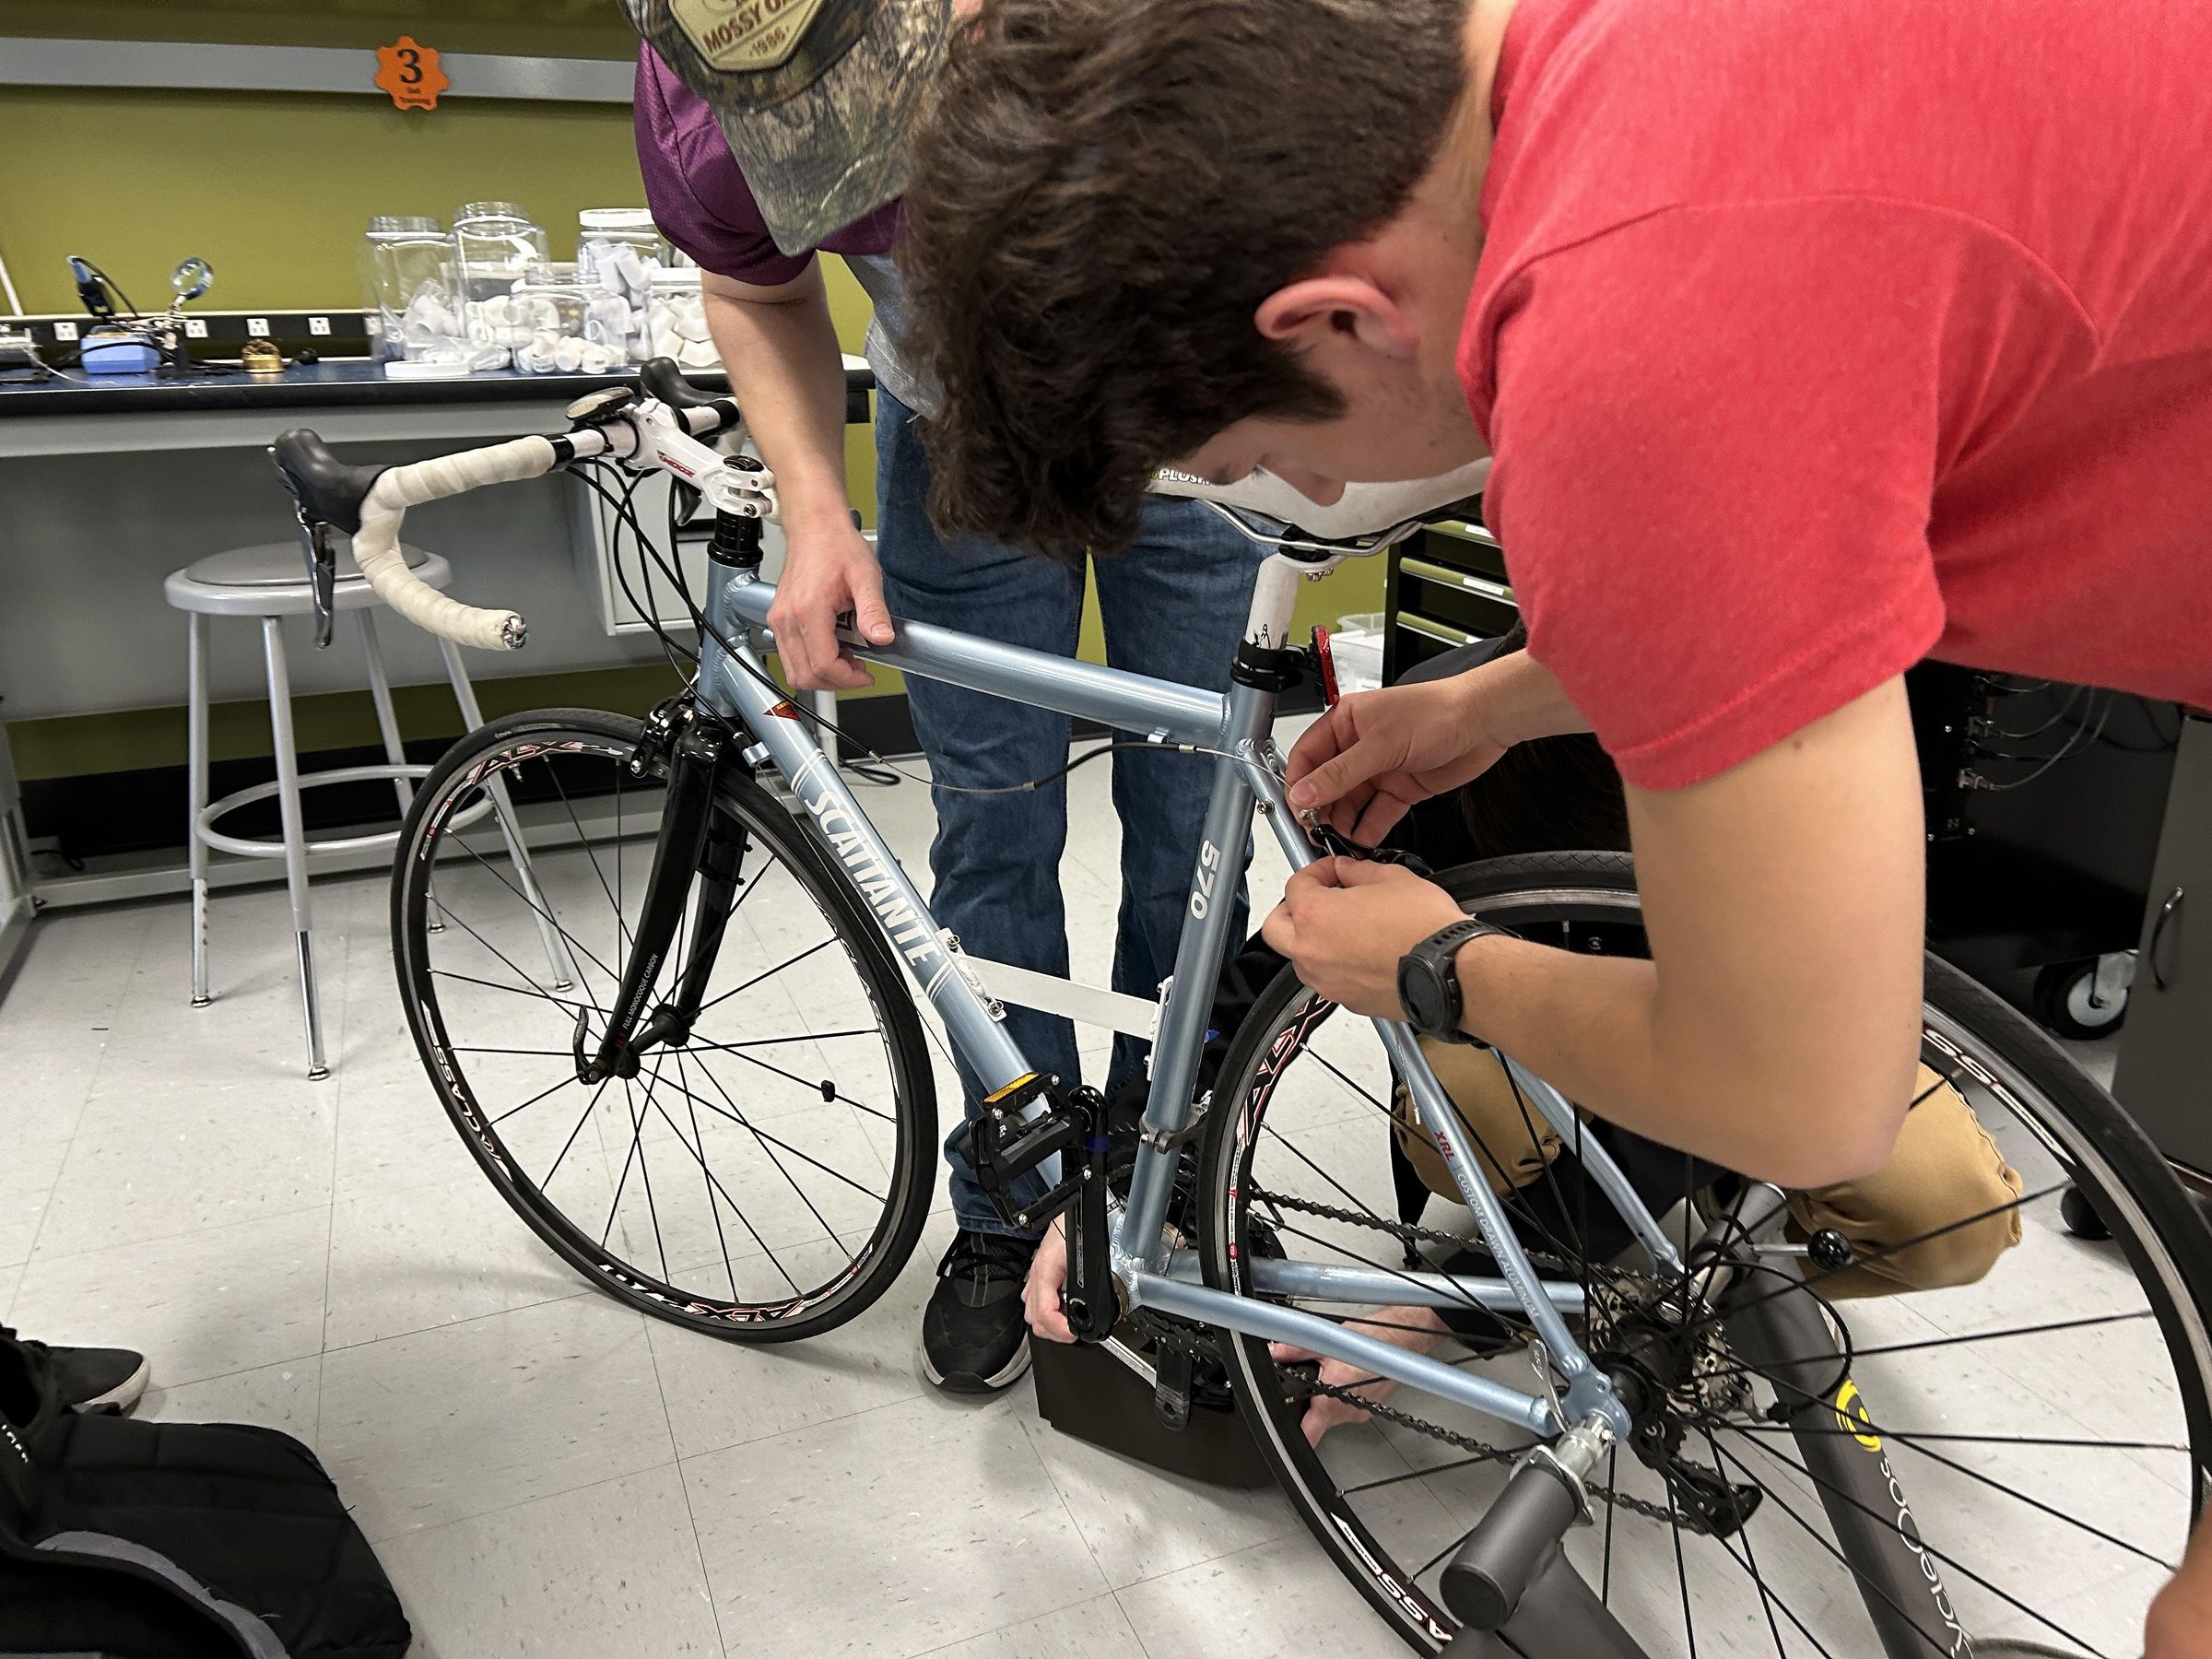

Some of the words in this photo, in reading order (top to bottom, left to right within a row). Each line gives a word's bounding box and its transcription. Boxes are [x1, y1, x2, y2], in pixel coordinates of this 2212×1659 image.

[397, 49, 422, 84] 3
[702, 2, 763, 53] MOSSY
[805, 790, 943, 967] SCATTANTE
[1190, 840, 1221, 920] 570
[622, 1015, 633, 1030] FULL
[629, 977, 649, 1018] MONOCOQUE
[643, 953, 659, 978] CARBON
[1433, 1130, 1455, 1163] XRL
[1457, 1172, 1482, 1218] CUSTOM
[1479, 1217, 1504, 1259] DRAWN
[1500, 1259, 1541, 1318] ALUMINUM
